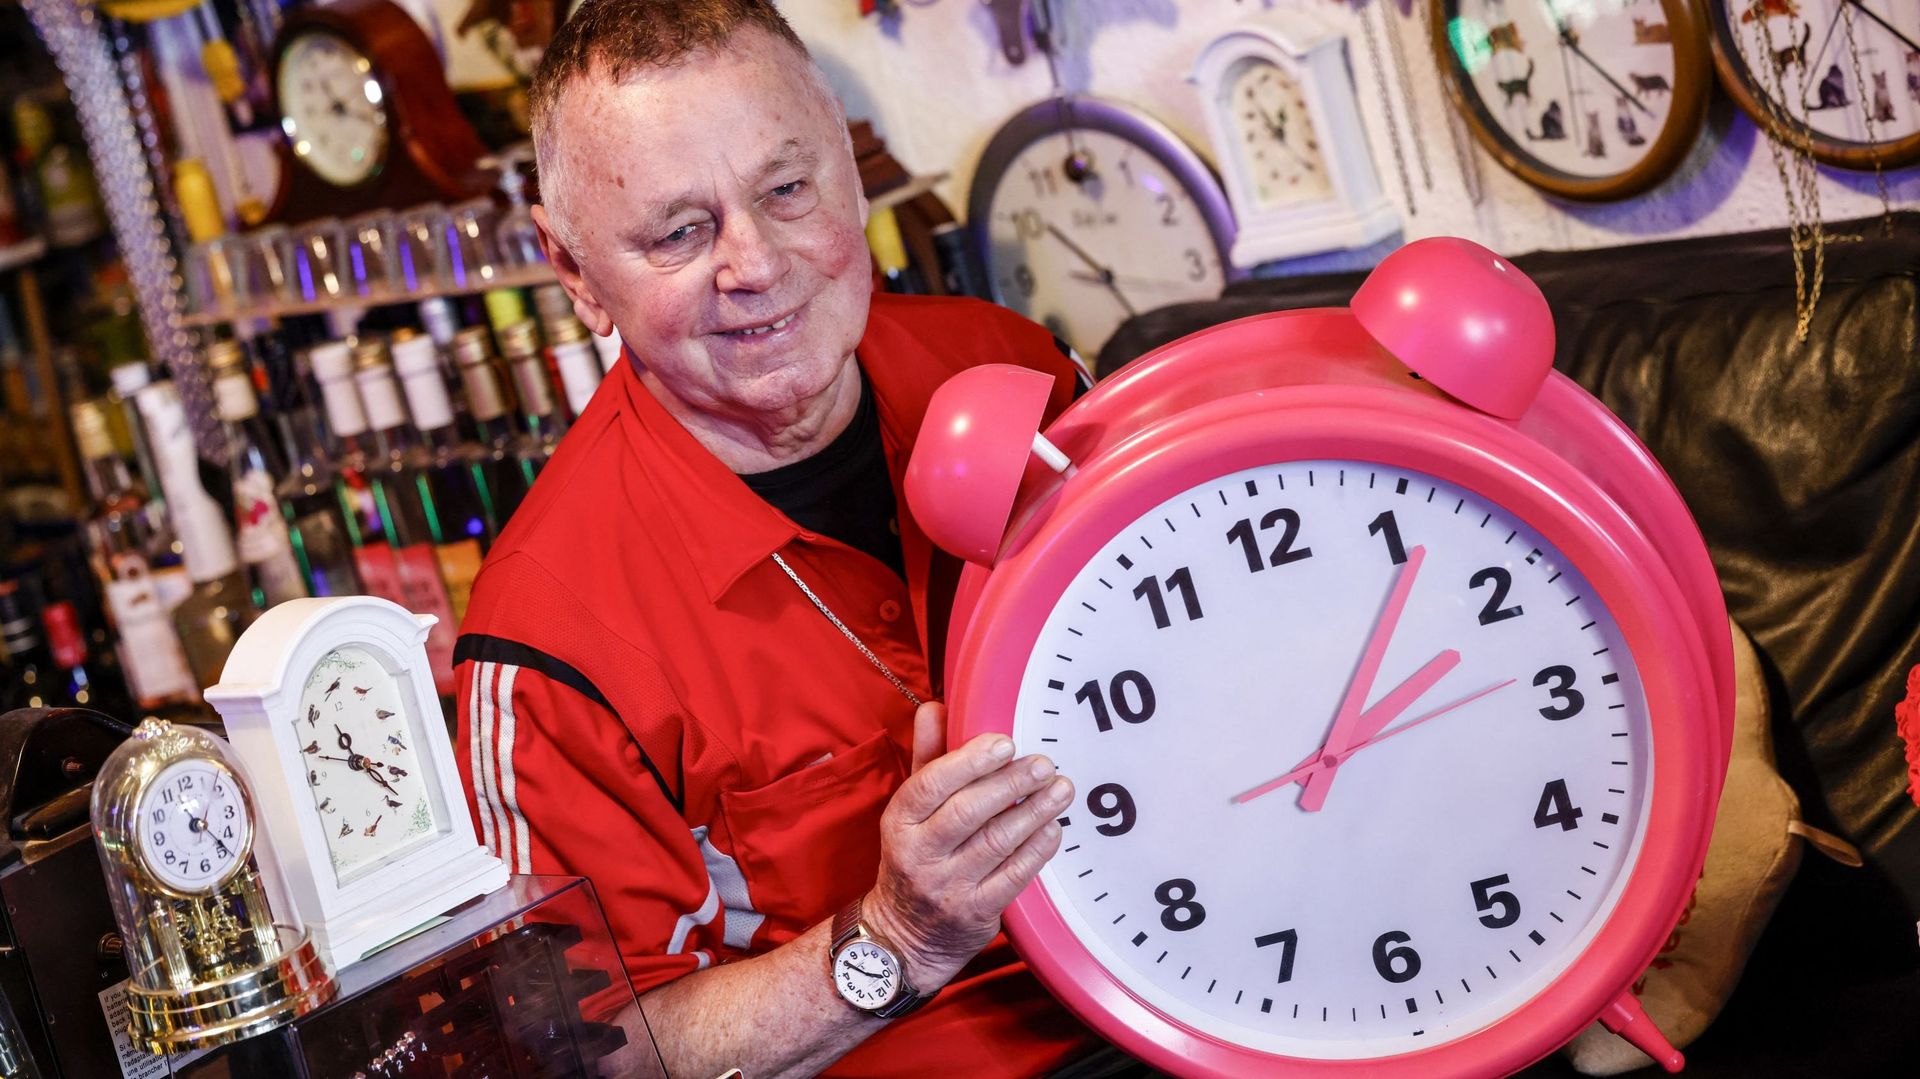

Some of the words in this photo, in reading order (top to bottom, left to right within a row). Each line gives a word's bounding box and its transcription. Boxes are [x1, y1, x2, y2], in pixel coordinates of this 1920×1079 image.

[1157, 194, 1180, 227] 2
[1183, 248, 1206, 283] 3
[1226, 508, 1313, 573] 12
[1368, 510, 1408, 565] 1
[1132, 566, 1204, 629] 11
[1469, 566, 1524, 626] 2
[1532, 664, 1585, 721] 3
[334, 701, 344, 712] 12
[1074, 670, 1156, 733] 10
[178, 775, 193, 792] 12
[321, 771, 328, 780] 9
[162, 788, 173, 804] 11
[224, 804, 235, 819] 3
[365, 809, 371, 817] 6
[1086, 782, 1137, 837] 9
[1533, 778, 1584, 832] 4
[152, 808, 165, 824] 10
[153, 831, 165, 846] 9
[223, 825, 233, 839] 4
[164, 849, 176, 865] 8
[216, 843, 228, 859] 5
[178, 859, 188, 874] 7
[200, 858, 211, 873] 6
[1154, 878, 1206, 932] 8
[1470, 873, 1521, 929] 5
[849, 951, 858, 960] 6
[861, 946, 869, 957] 7
[870, 950, 879, 959] 8
[1254, 928, 1298, 984] 7
[1372, 930, 1422, 984] 6
[842, 972, 850, 981] 4
[882, 967, 893, 978] 10
[847, 981, 855, 990] 3
[883, 978, 892, 988] 11
[855, 989, 865, 998] 2
[867, 992, 875, 1001] 1
[875, 986, 887, 998] 12
[111, 1017, 125, 1027] back
[384, 1068, 391, 1078] 1
[396, 1059, 404, 1072] 2
[408, 1050, 415, 1062] 3
[421, 1042, 427, 1052] 4
